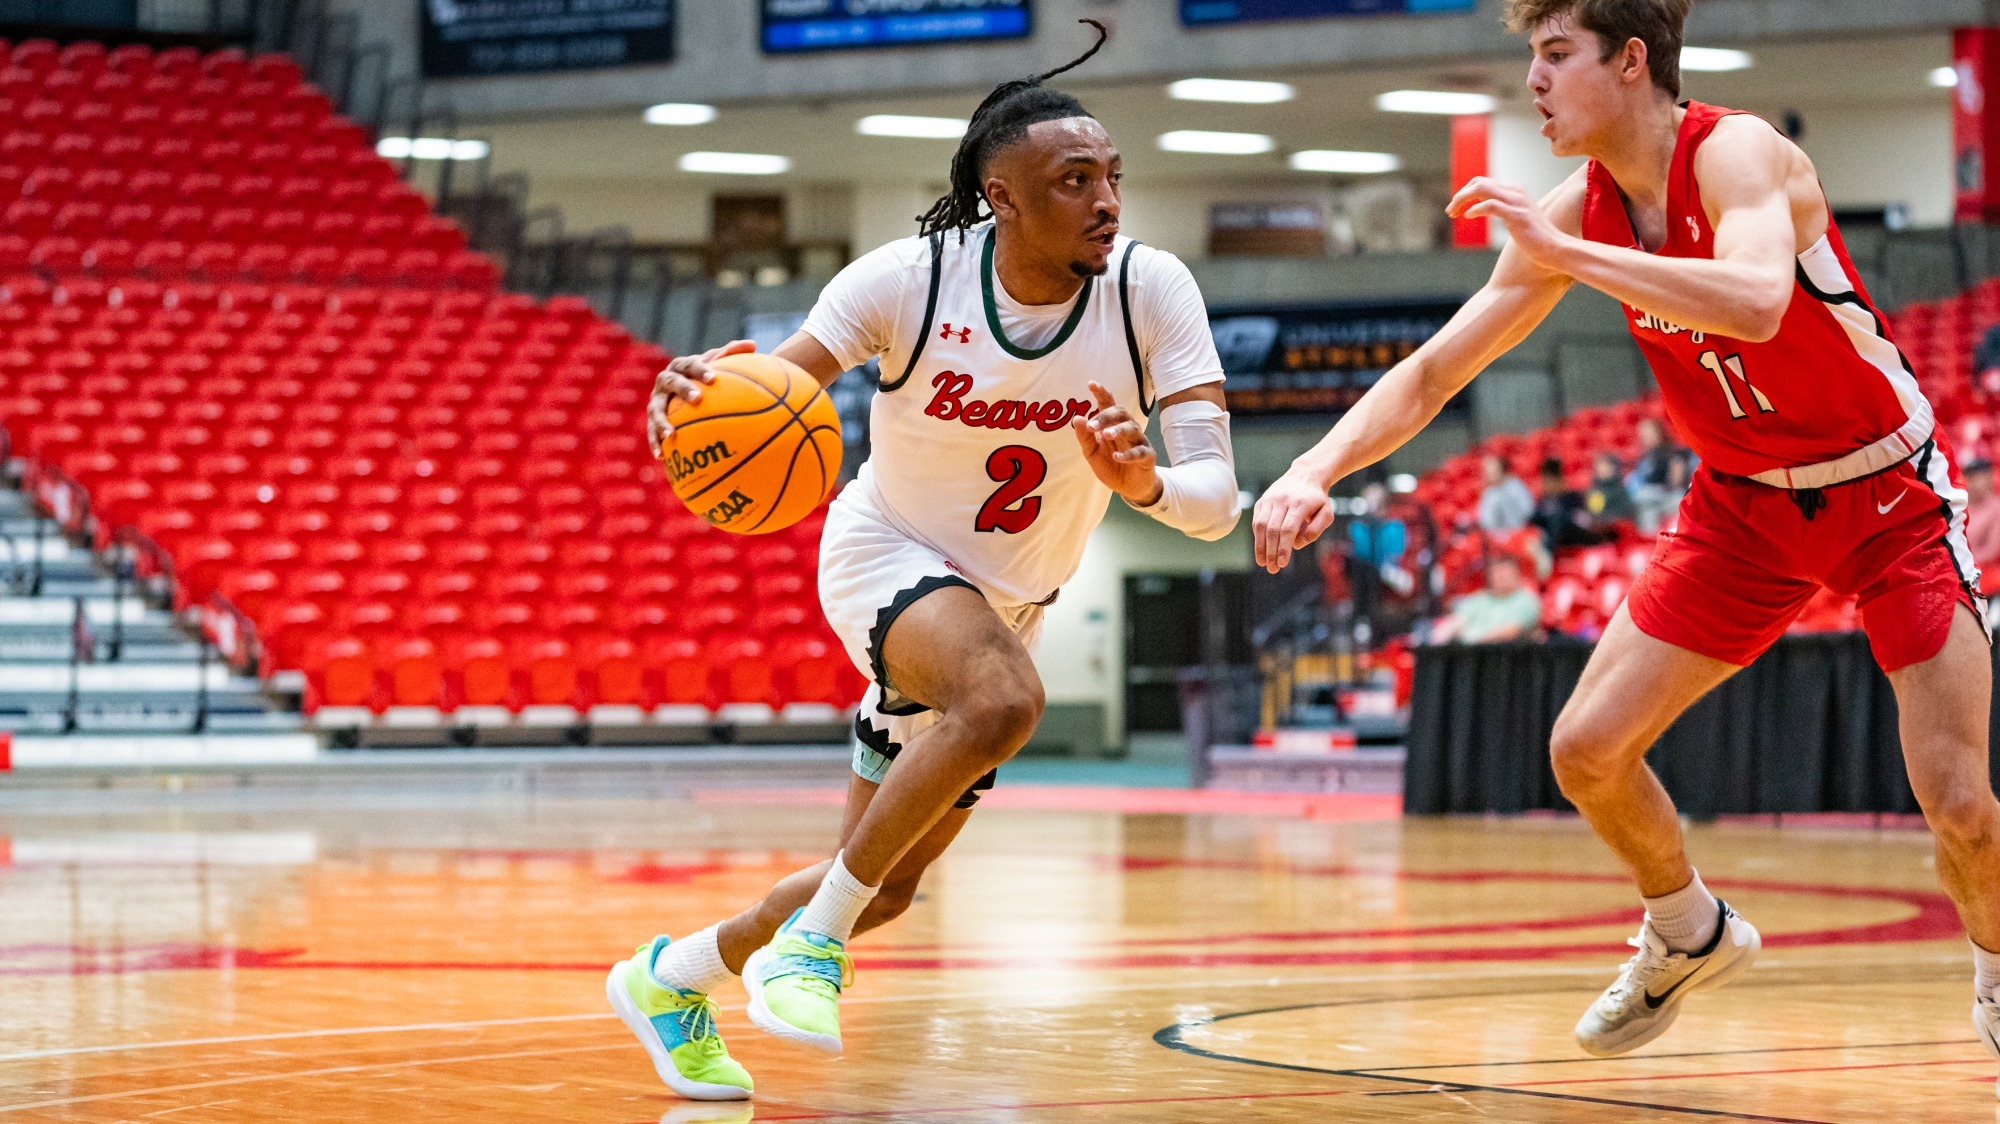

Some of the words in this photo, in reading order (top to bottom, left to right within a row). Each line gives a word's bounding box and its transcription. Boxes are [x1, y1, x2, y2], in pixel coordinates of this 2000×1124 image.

[924, 370, 1100, 432] Beaver
[1697, 350, 1778, 421] 11
[663, 440, 733, 485] ilson
[974, 444, 1048, 534] 2
[702, 489, 754, 524] CAA
